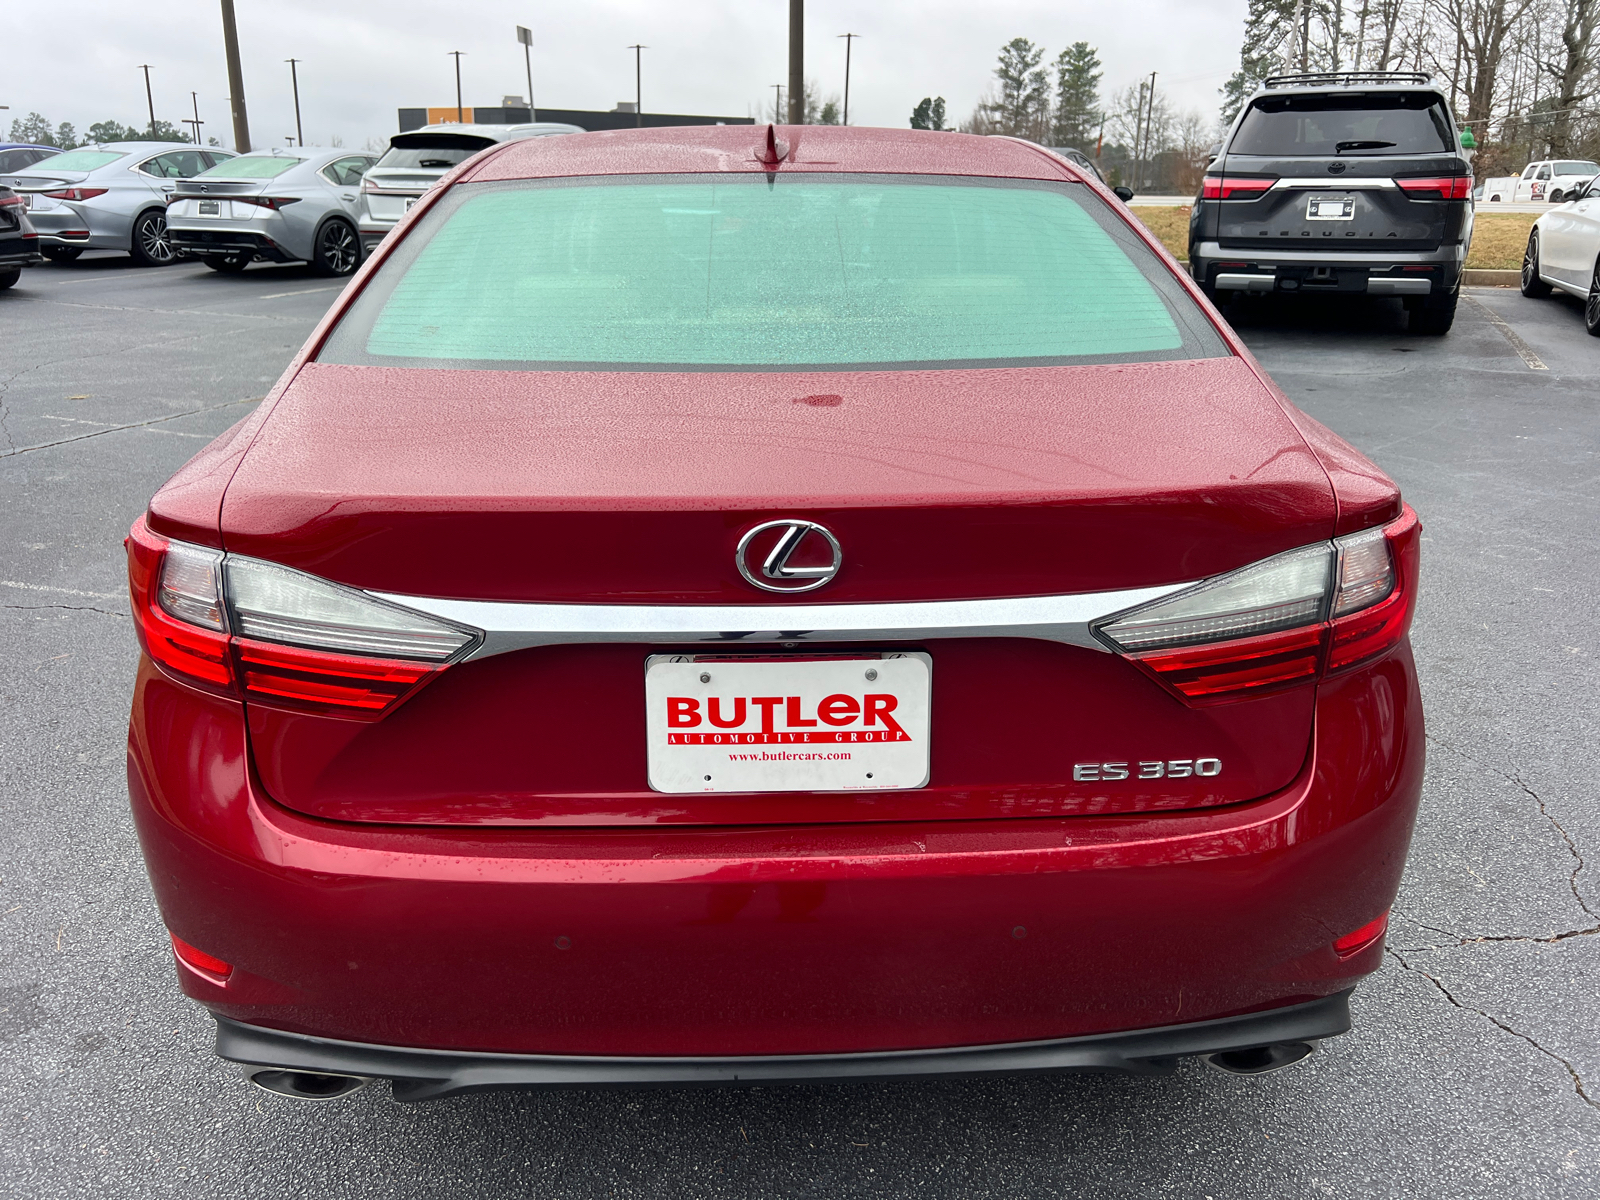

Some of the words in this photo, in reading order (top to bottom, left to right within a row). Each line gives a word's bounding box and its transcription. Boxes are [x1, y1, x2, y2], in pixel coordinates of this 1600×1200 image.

[669, 733, 811, 743] AUTOMOTIVE
[835, 731, 903, 742] GROUP
[728, 751, 851, 761] www.butlercars.com
[1073, 762, 1129, 781] ES
[1138, 758, 1222, 778] 350
